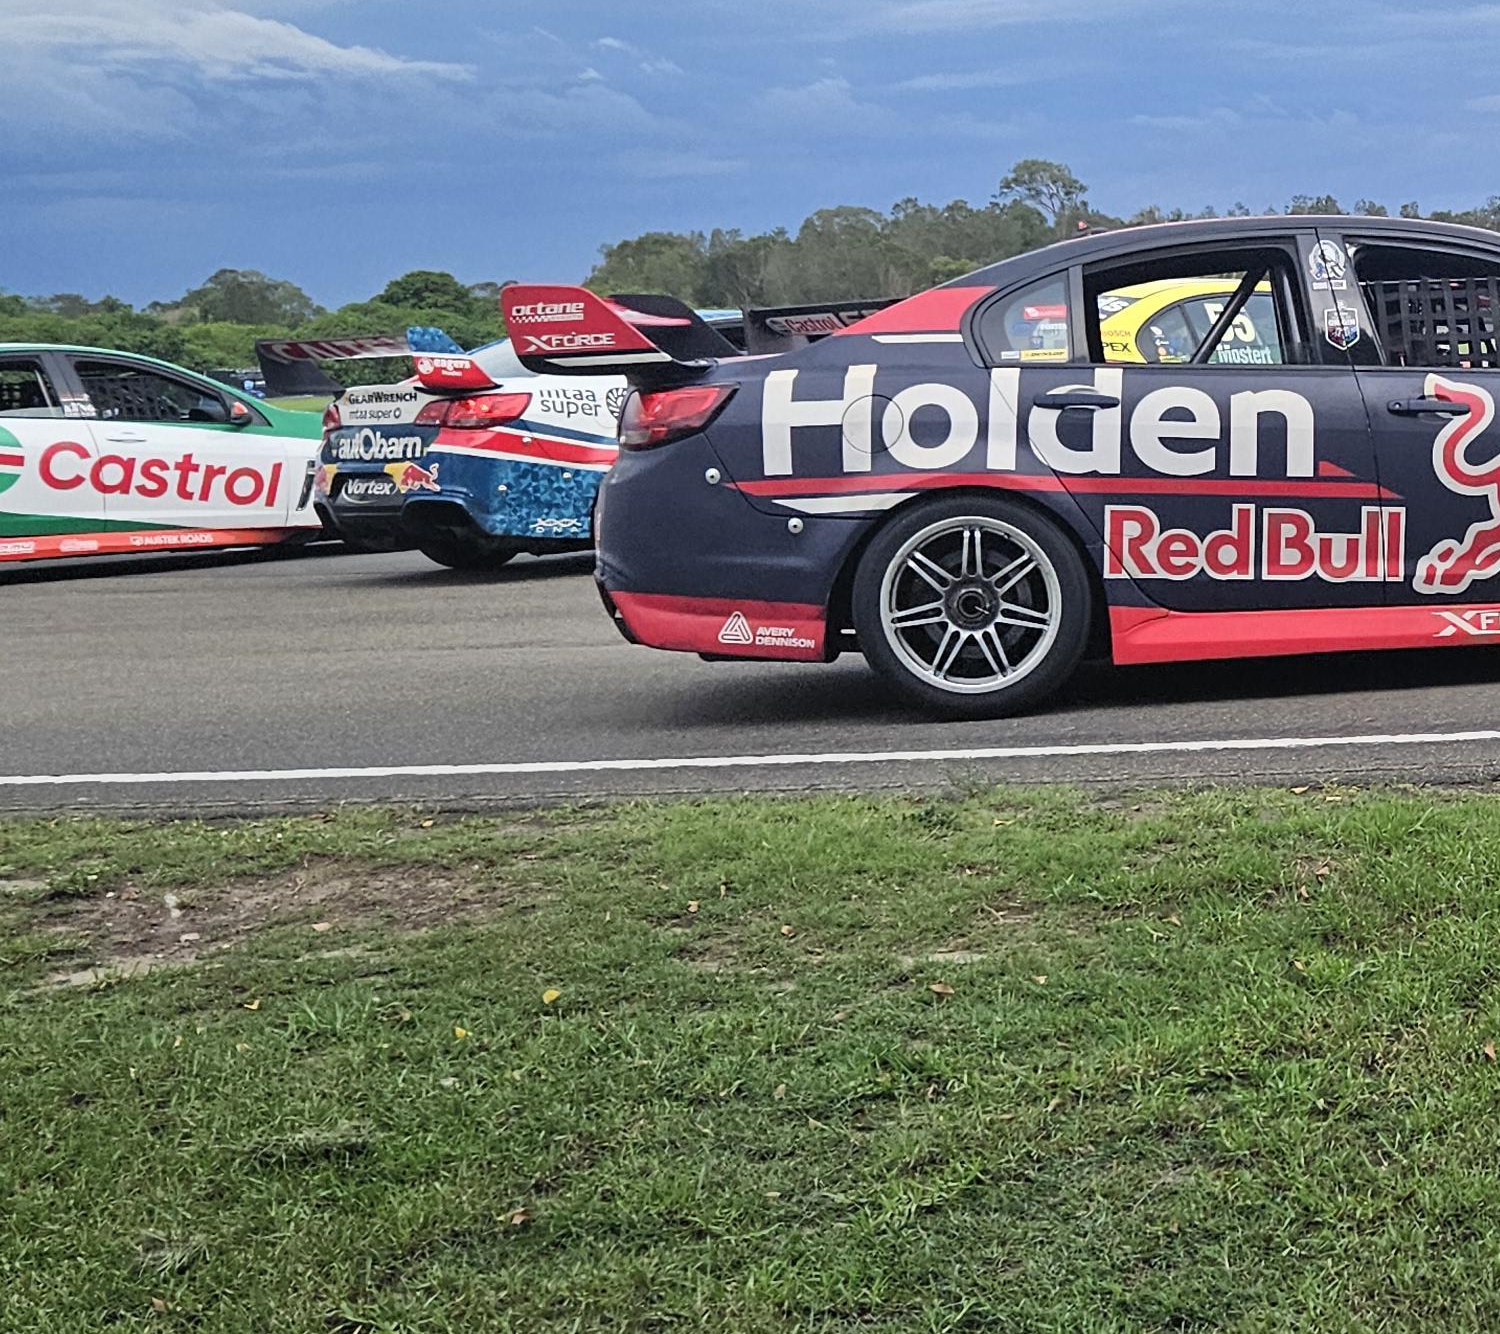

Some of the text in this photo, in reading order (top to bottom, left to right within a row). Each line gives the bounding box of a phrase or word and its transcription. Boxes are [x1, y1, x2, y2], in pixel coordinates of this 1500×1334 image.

[511, 301, 585, 317] octane
[784, 316, 841, 334] Castrol
[1217, 344, 1274, 364] Mostert
[540, 399, 602, 418] super
[761, 364, 1315, 477] Holden
[39, 441, 283, 507] Castrol
[347, 478, 394, 496] Vortex
[1103, 503, 1406, 582] Red Bull
[756, 626, 796, 637] AVERY
[755, 636, 816, 649] DENNISON
